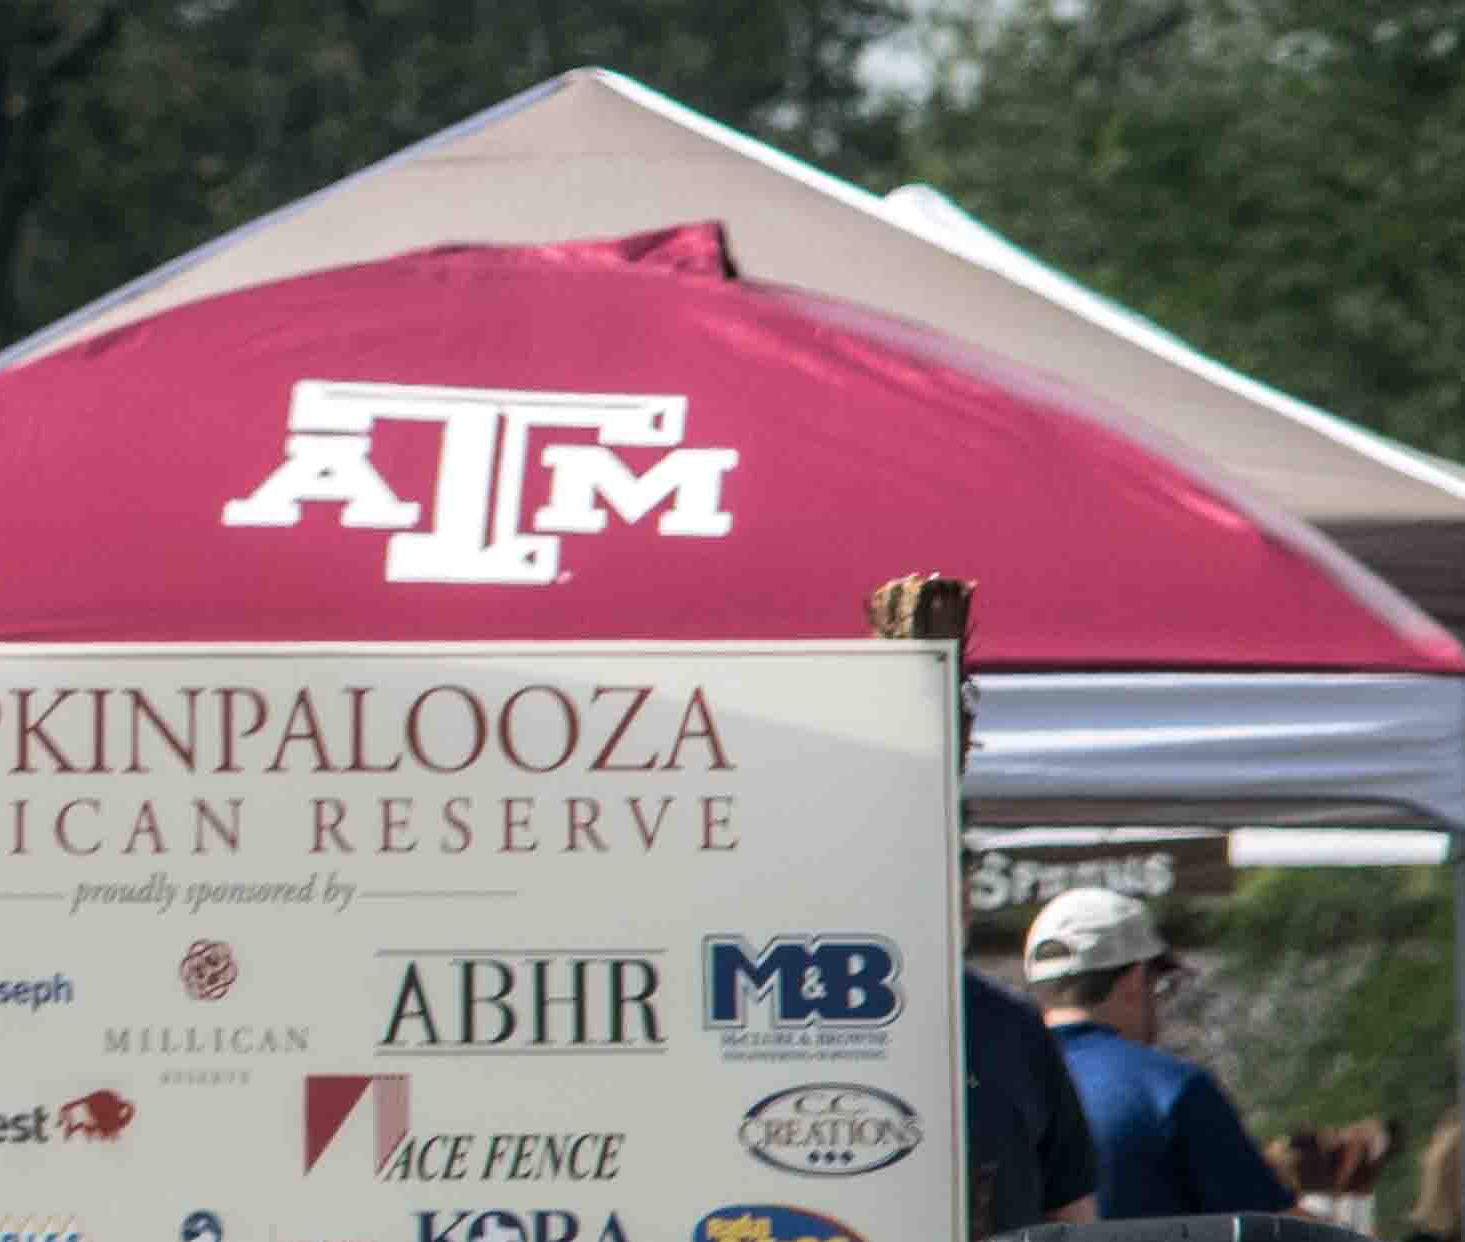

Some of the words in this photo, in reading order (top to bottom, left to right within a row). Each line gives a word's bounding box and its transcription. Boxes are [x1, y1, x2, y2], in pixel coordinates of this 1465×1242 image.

[308, 796, 741, 855] RESERVE
[69, 871, 179, 915] proudly
[182, 872, 316, 909] sponsored
[321, 871, 357, 914] by
[376, 957, 669, 1045] ABHR
[703, 935, 905, 1030] M&B
[102, 1025, 313, 1054] MILLICAN
[382, 1133, 475, 1182] ACE
[479, 1133, 627, 1182] FENCE
[738, 1116, 924, 1151] CREATIONS
